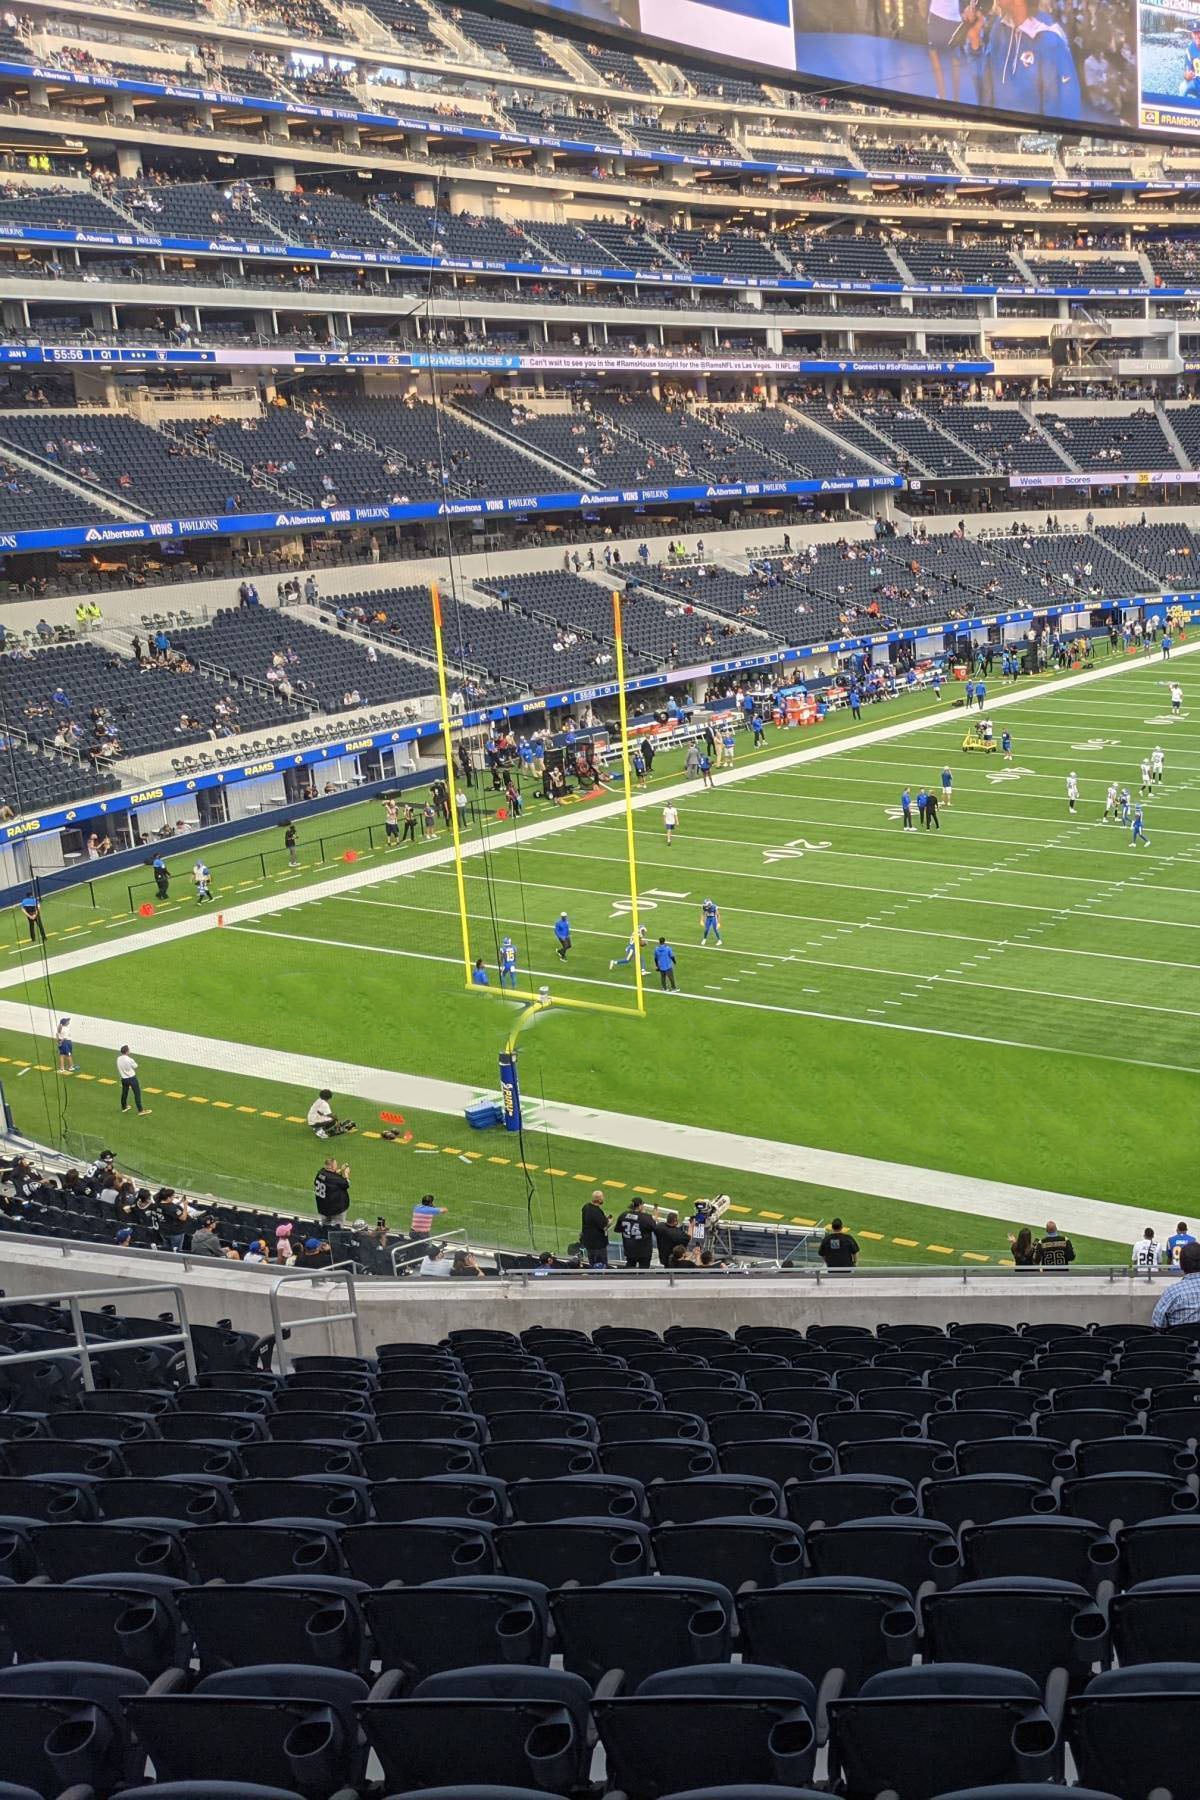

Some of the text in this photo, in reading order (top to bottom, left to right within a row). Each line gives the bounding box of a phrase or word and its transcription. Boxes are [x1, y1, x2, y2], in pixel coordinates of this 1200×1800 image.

[54, 350, 84, 360] 55:56
[100, 350, 112, 360] Q1
[853, 363, 878, 371] Connect
[1020, 475, 1092, 486] Week Scores
[486, 500, 504, 510] VONS
[289, 514, 326, 525] Albertsons
[330, 510, 351, 522] VONS
[102, 520, 219, 540] Albertsons VONS PAVILIONS
[522, 700, 546, 710] RAMS
[345, 738, 373, 752] RAMS
[244, 762, 275, 776] RAMS
[130, 788, 164, 804] RAMS
[6, 820, 40, 838] RAMS
[1140, 1252, 1154, 1266] 28
